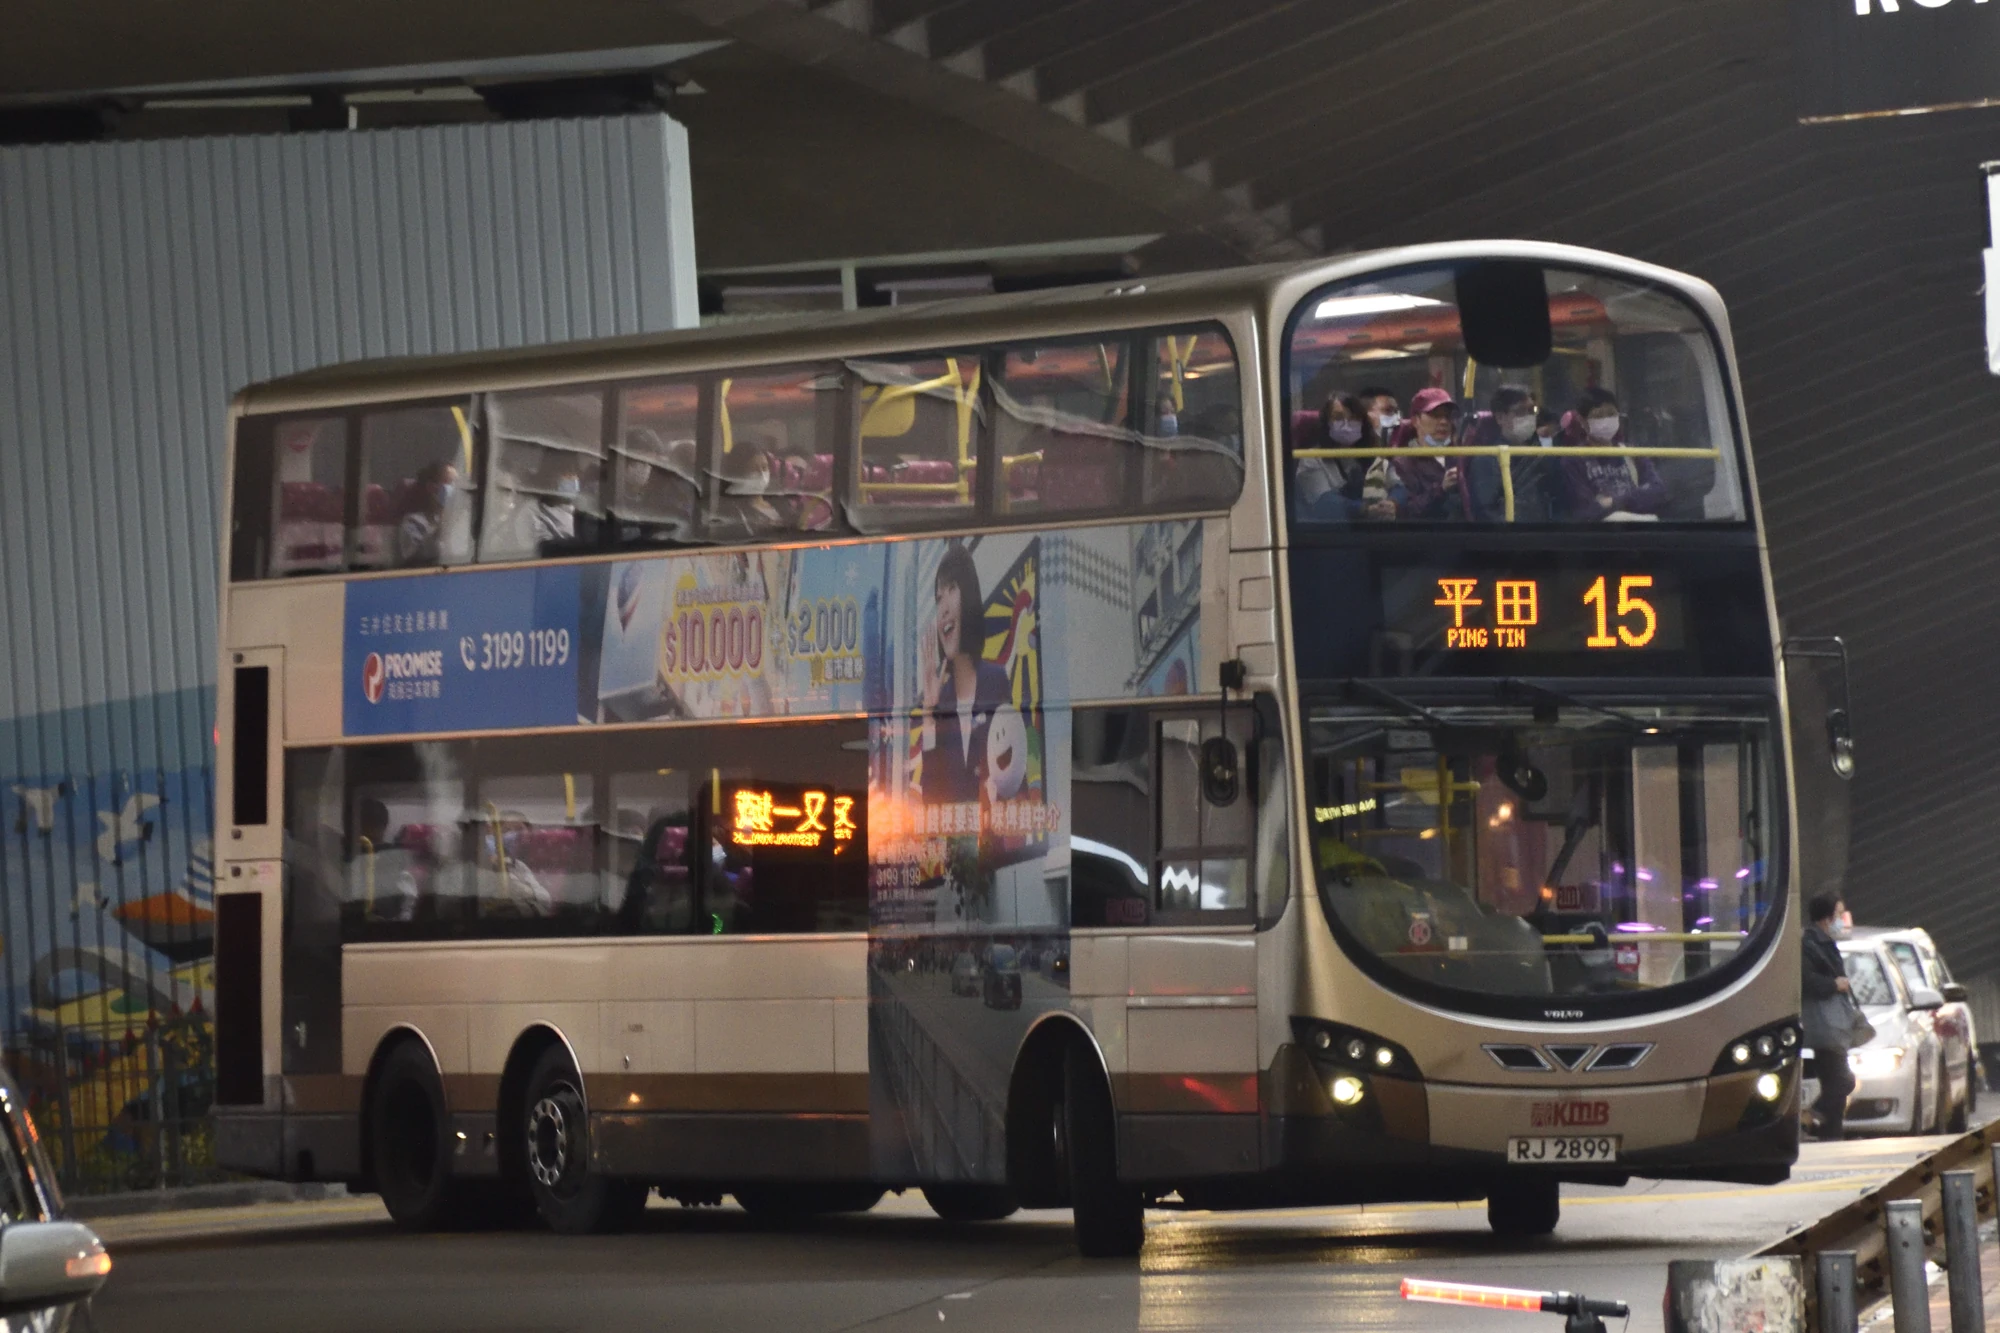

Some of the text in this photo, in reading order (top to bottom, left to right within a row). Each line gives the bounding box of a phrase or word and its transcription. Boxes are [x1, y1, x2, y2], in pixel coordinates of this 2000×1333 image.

[1434, 578, 1538, 628] 平田
[1583, 575, 1658, 647] 15
[481, 627, 570, 671] 3199 1199
[1447, 627, 1526, 648] PING TIN
[384, 650, 443, 679] PROMISE
[876, 867, 921, 886] 3199 1199
[1544, 1010, 1584, 1019] VOLVO
[1553, 1101, 1609, 1127] KMB
[1517, 1138, 1610, 1160] RJ 2899
